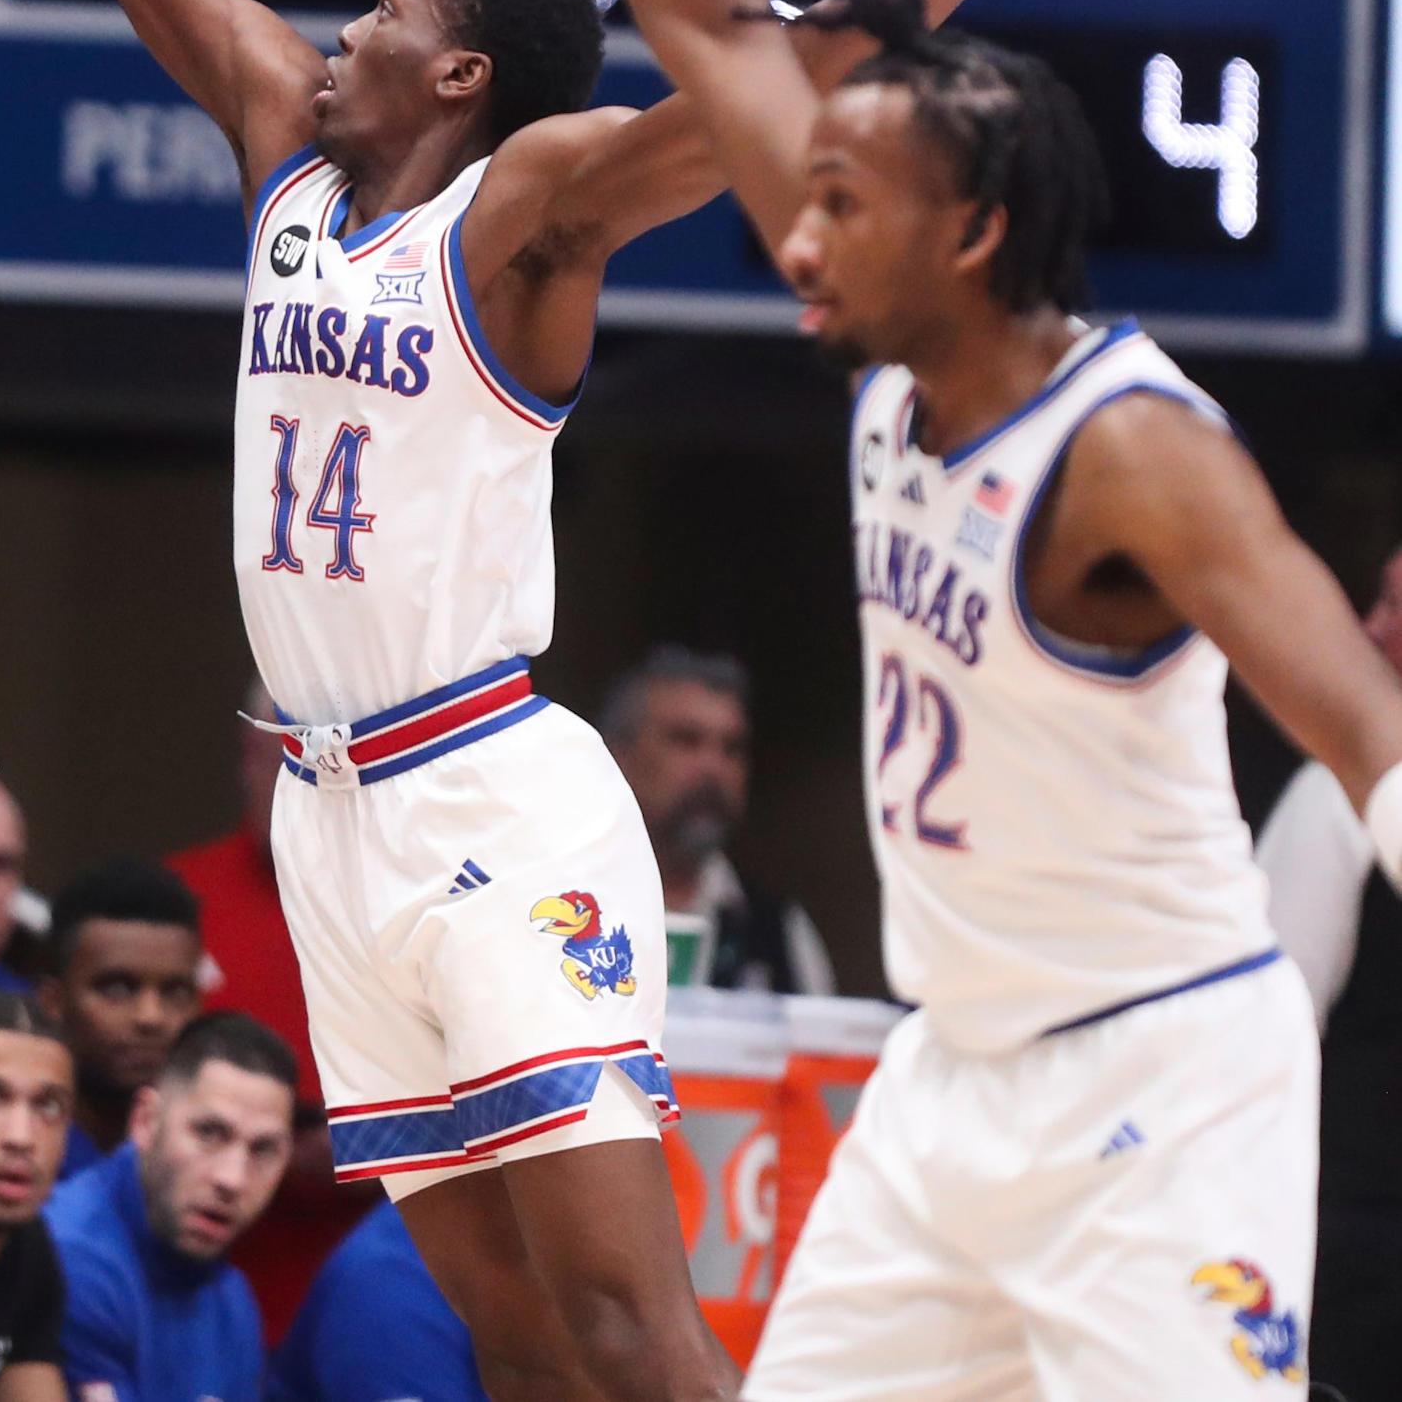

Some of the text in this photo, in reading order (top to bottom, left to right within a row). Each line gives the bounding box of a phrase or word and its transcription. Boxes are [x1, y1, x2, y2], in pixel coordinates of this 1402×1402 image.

[1142, 53, 1260, 240] 4
[249, 300, 435, 398] KANSAS
[261, 414, 378, 582] 14
[877, 651, 972, 850] 22
[586, 945, 616, 969] KU
